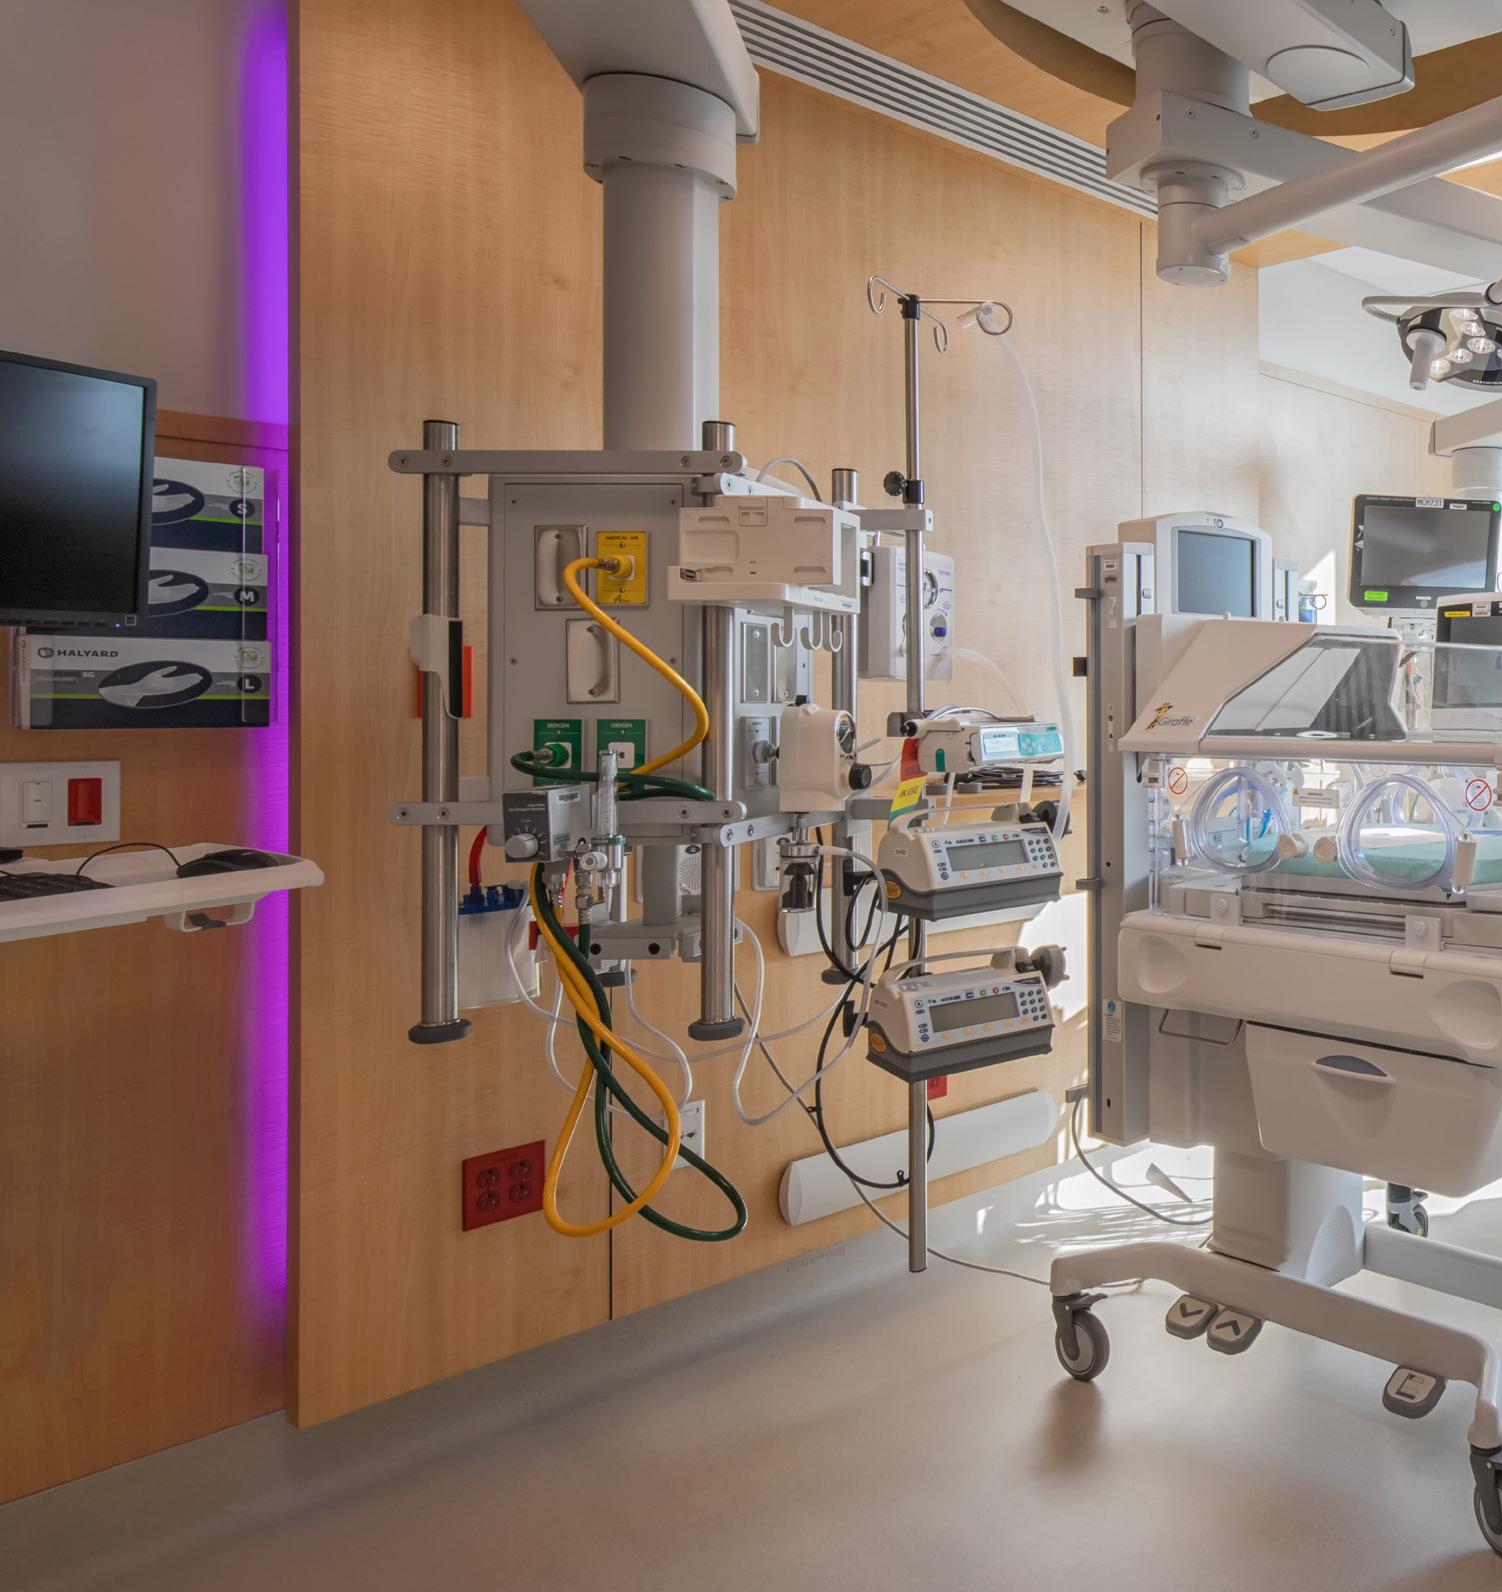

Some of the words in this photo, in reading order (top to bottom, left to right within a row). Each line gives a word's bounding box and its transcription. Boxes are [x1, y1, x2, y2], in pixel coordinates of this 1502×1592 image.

[238, 503, 247, 514] S
[240, 591, 254, 602] M
[57, 649, 119, 658] HALYARD
[245, 679, 254, 689] L
[1158, 715, 1193, 727] Giraffe
